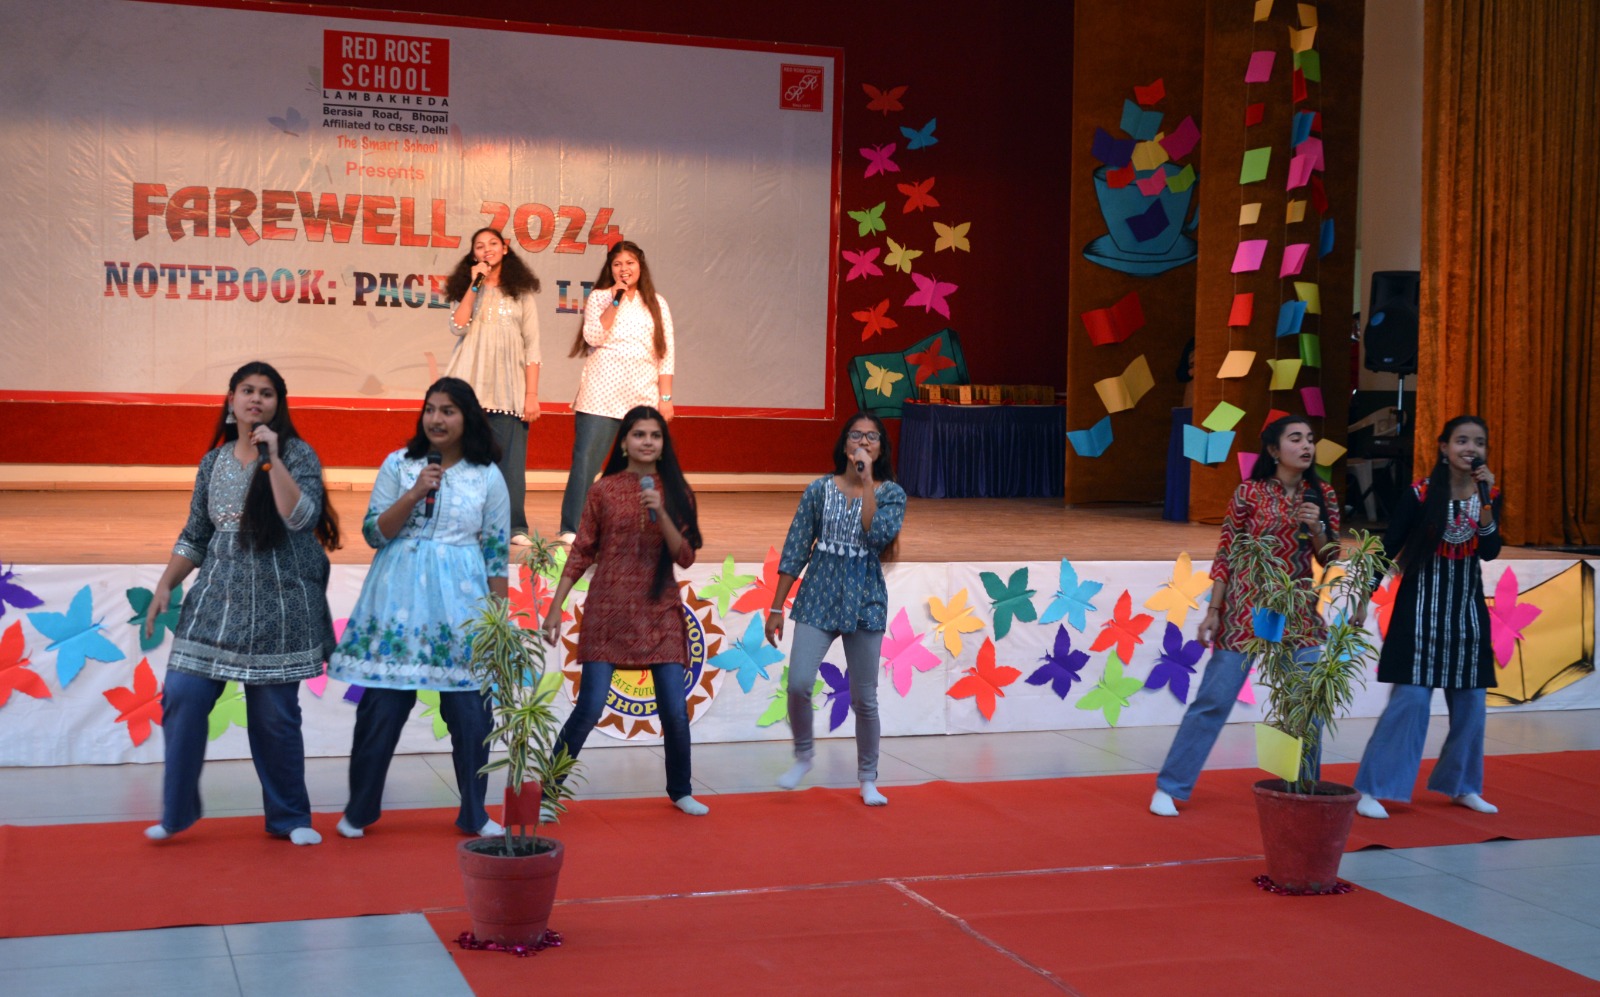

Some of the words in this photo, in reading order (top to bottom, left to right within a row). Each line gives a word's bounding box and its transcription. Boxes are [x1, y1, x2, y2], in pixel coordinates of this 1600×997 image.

[341, 35, 378, 60] RED
[384, 39, 432, 65] ROSE
[341, 63, 432, 92] SCHOOL
[322, 90, 449, 107] LAMBAKHEDA
[322, 106, 363, 118] Berasia
[372, 109, 403, 121] Road,
[412, 112, 448, 124] Bhopal
[322, 119, 371, 131] Affiliated
[374, 121, 385, 131] to
[388, 123, 418, 135] CBSE,
[421, 125, 448, 135] Delhi
[337, 134, 358, 149] The
[361, 136, 399, 152] Smart
[403, 138, 438, 153] School
[345, 161, 425, 180] Presents
[132, 182, 462, 249] FAREWELL
[480, 200, 625, 255] 2024
[103, 261, 337, 305] NOTEBOOK:
[632, 686, 656, 697] FUTU
[606, 689, 658, 715] BHOP
